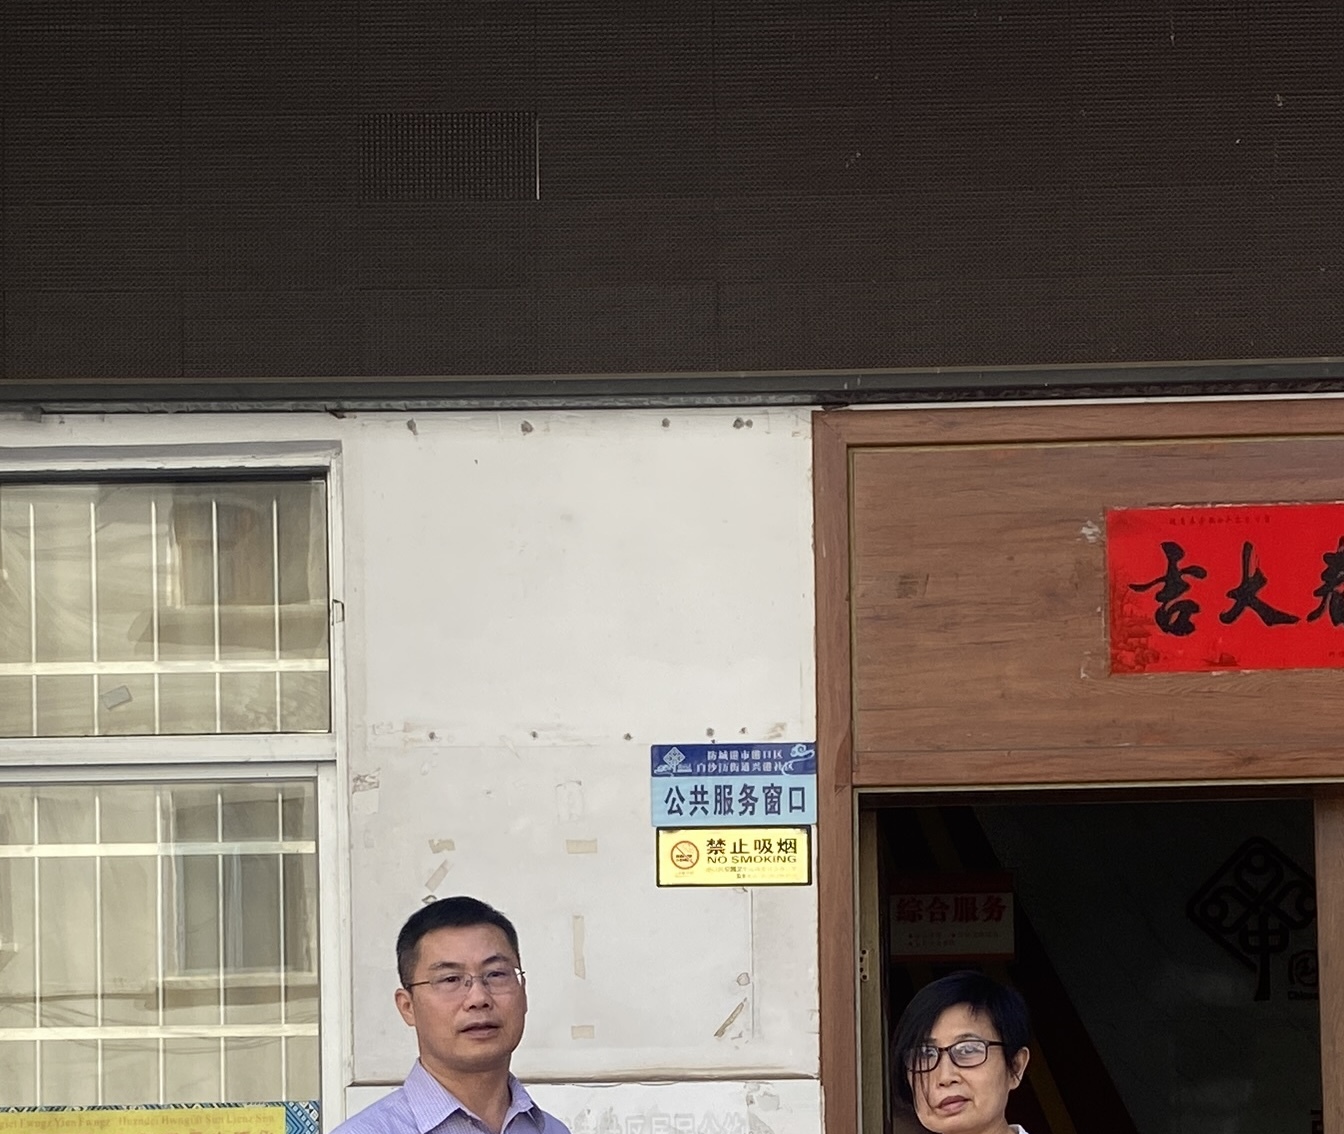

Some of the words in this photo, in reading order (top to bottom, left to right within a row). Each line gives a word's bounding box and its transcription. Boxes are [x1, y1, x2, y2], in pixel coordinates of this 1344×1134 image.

[664, 783, 806, 816] 公共服务窗口
[706, 838, 798, 855] 禁止吸烟
[707, 855, 728, 865] NO
[731, 855, 797, 864] SMOKING
